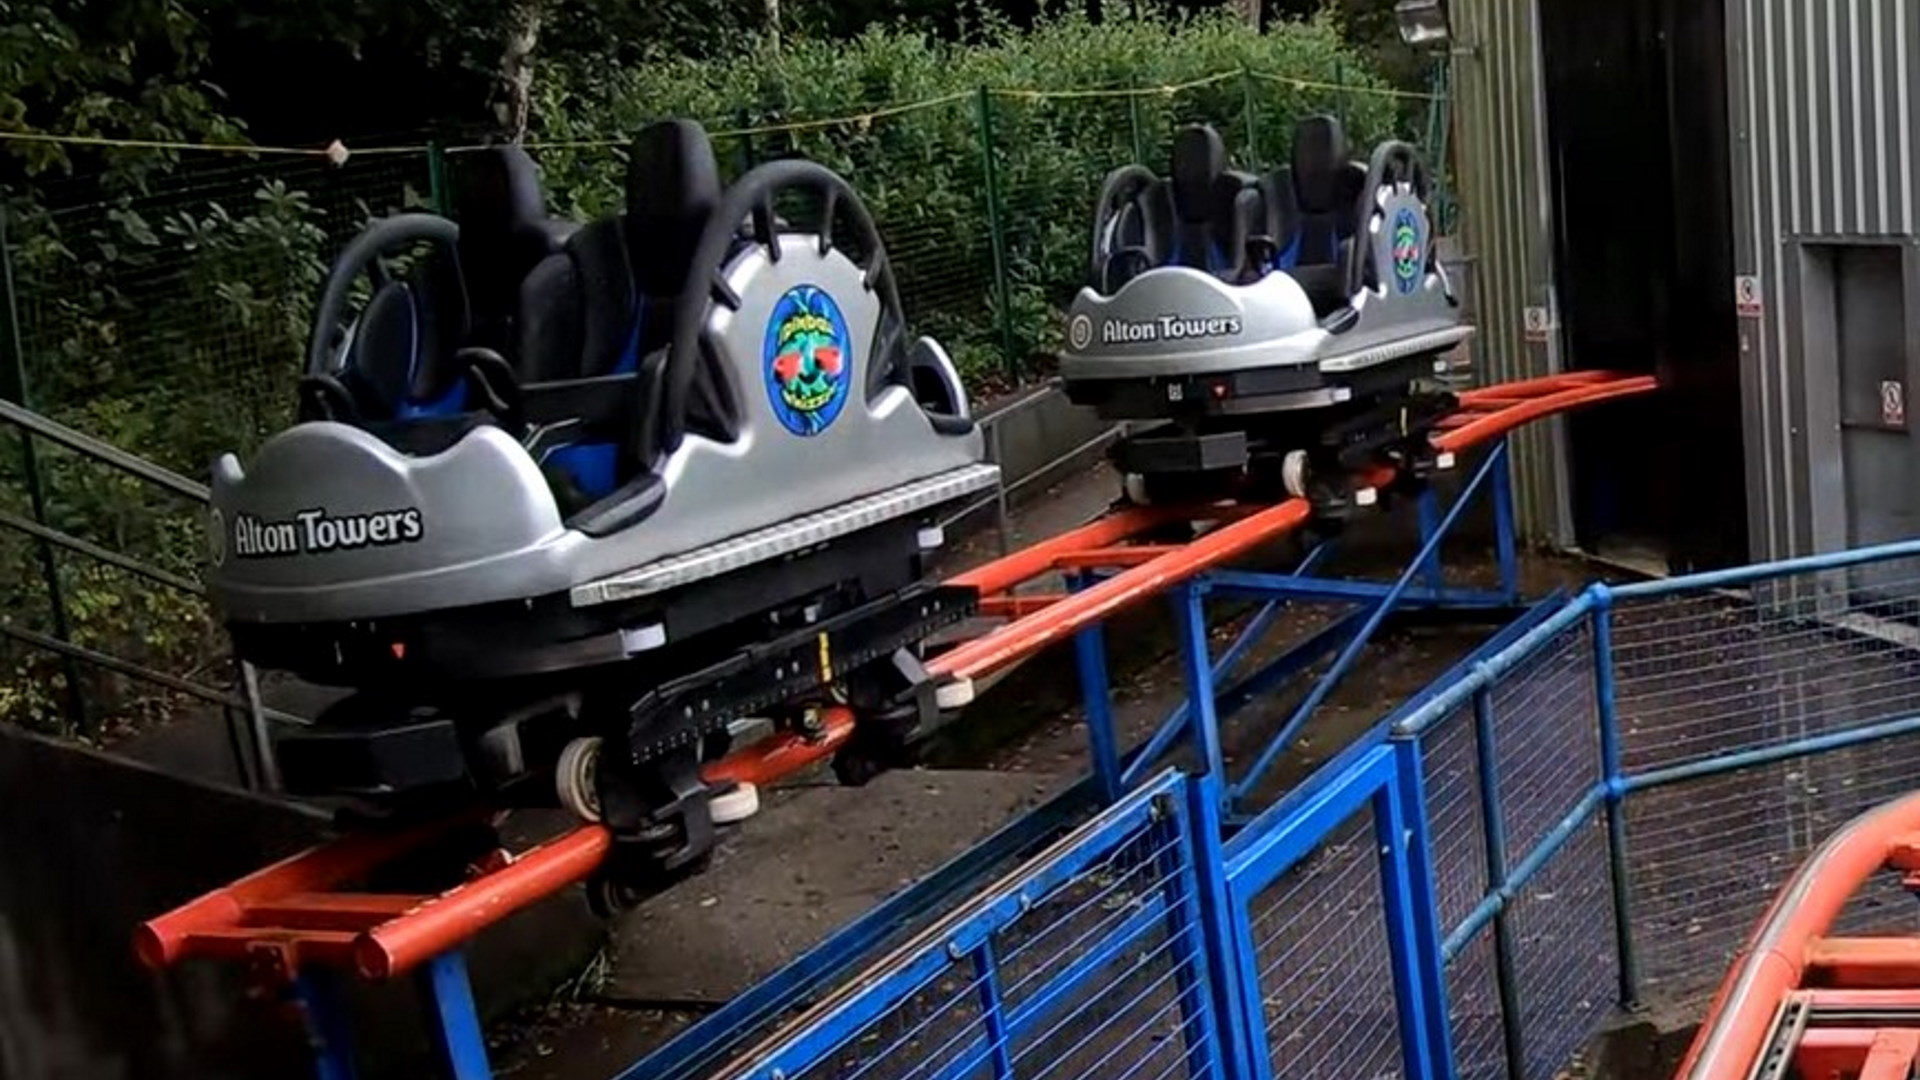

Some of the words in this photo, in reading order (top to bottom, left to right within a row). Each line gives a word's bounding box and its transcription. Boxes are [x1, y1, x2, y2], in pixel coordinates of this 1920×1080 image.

[1102, 320, 1156, 343] Alton
[1158, 315, 1241, 338] Towers
[235, 515, 297, 556] Alton
[297, 509, 422, 550] Towers
